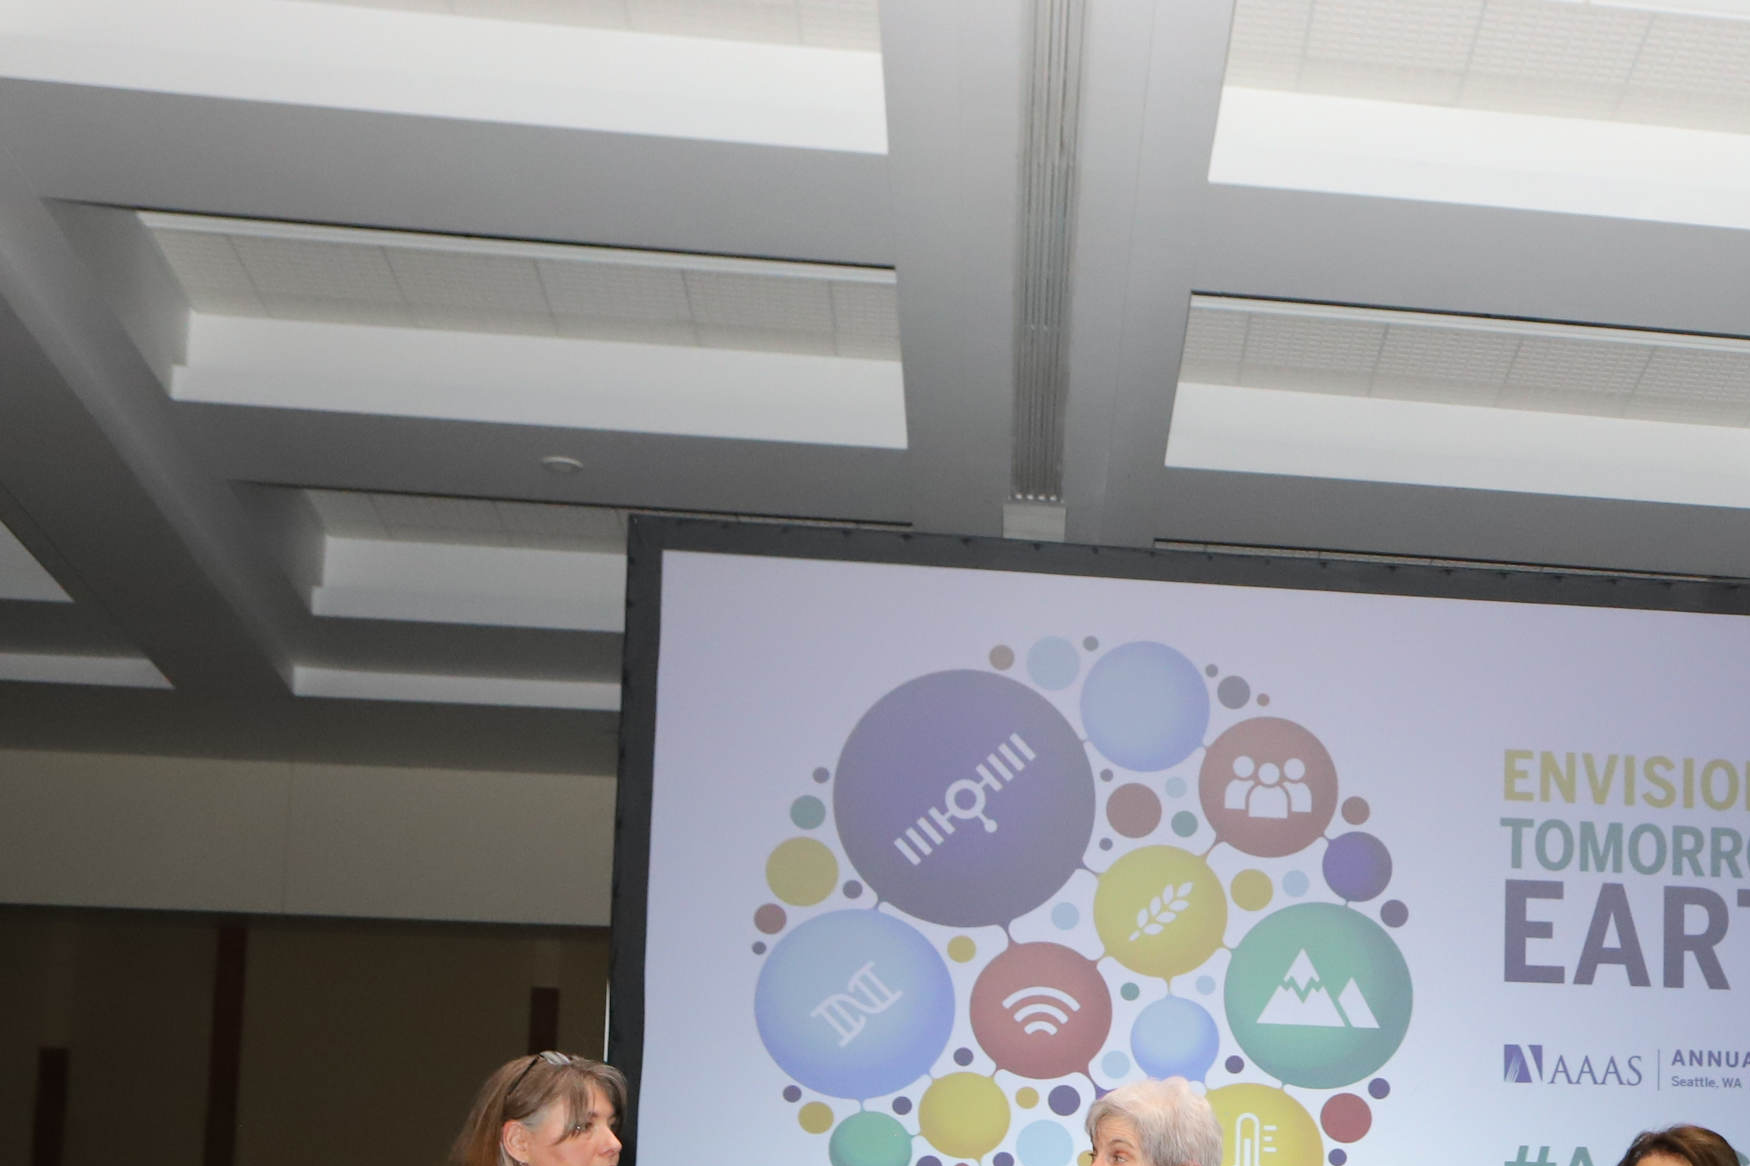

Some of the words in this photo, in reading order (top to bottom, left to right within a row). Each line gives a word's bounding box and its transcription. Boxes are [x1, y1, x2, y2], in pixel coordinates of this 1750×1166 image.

[1547, 1054, 1643, 1087] AAAS
[1671, 1076, 1719, 1089] Seattle,
[1722, 1077, 1742, 1089] WA
